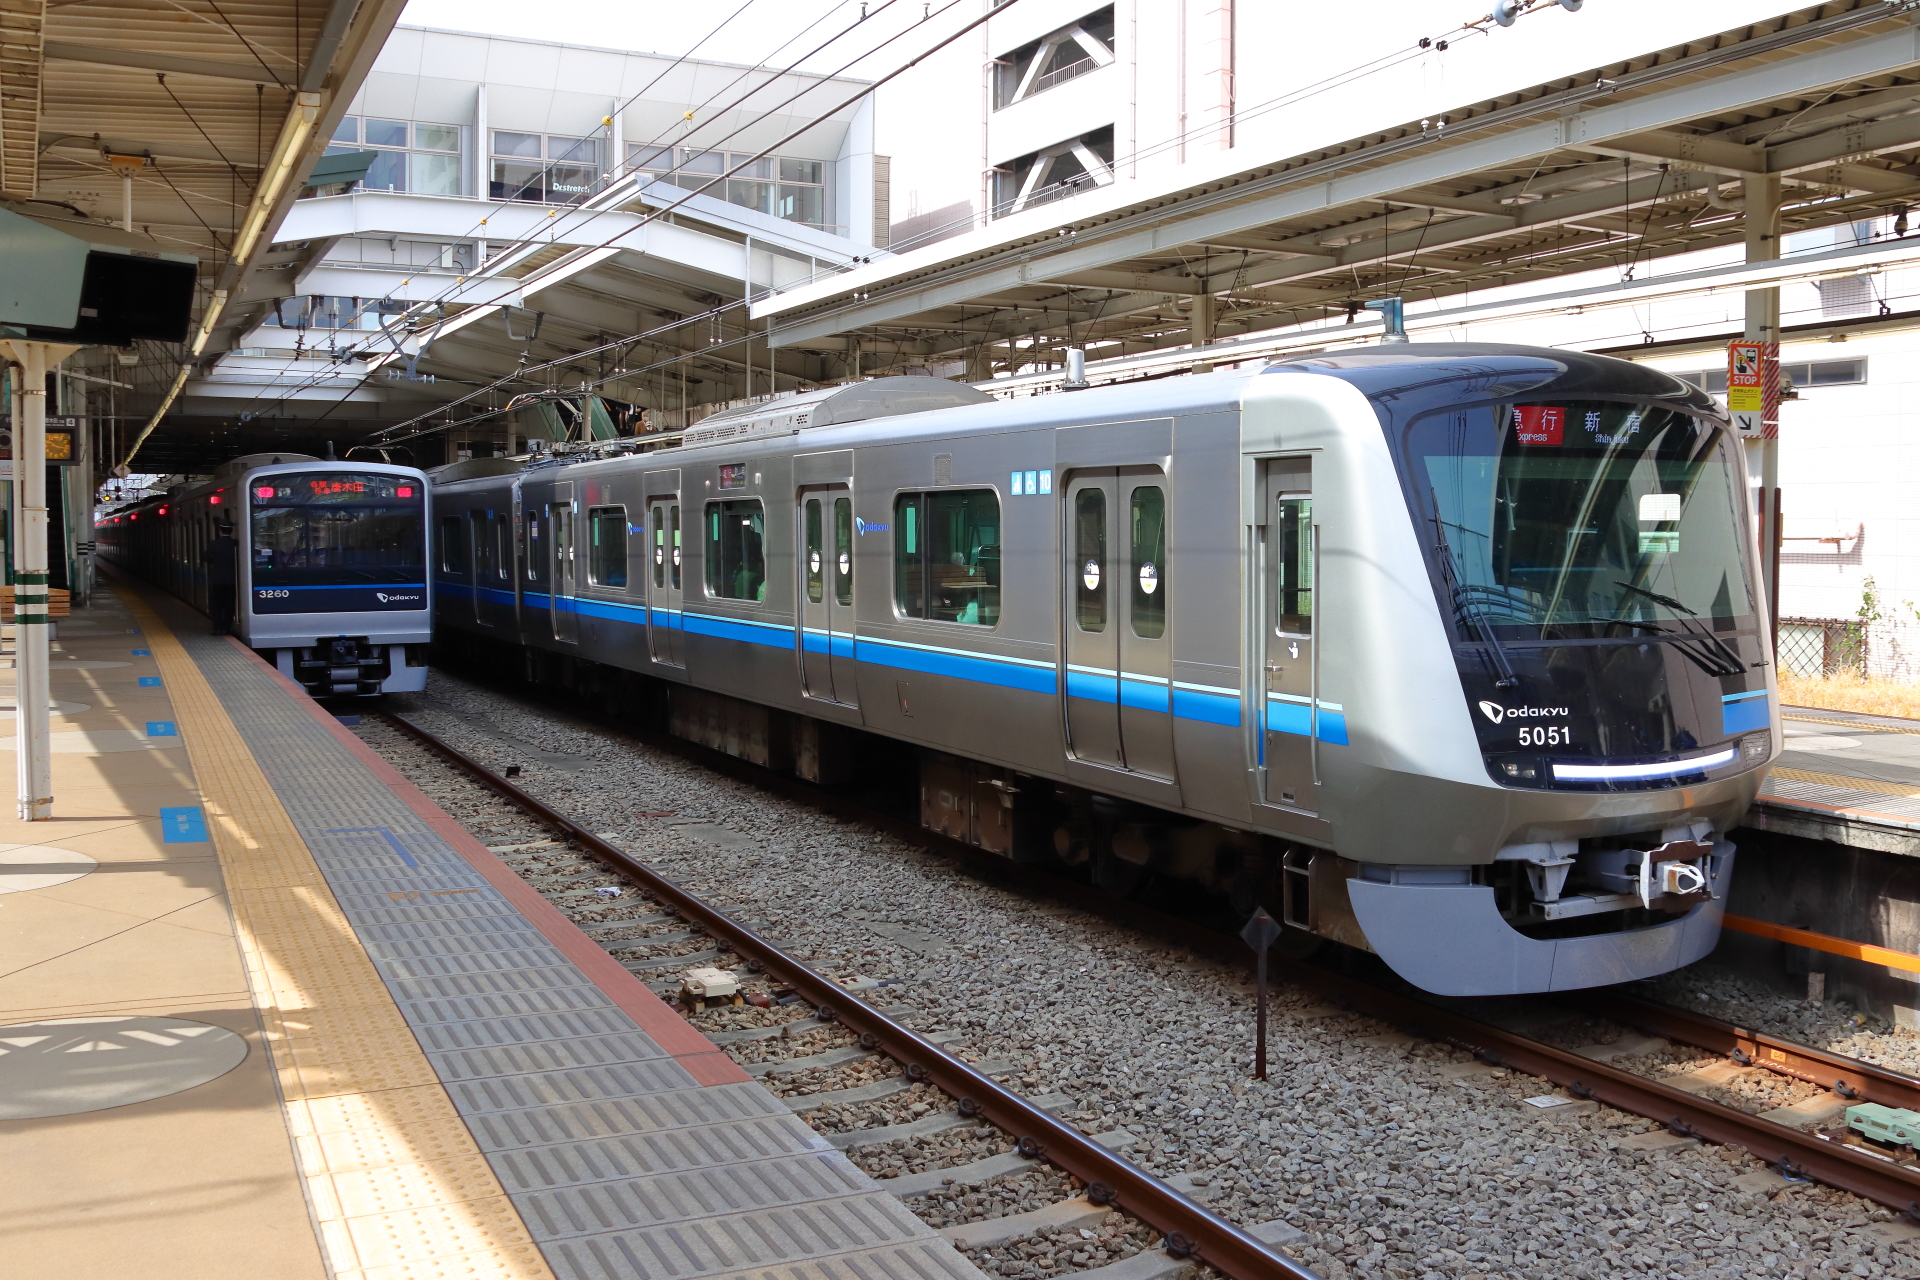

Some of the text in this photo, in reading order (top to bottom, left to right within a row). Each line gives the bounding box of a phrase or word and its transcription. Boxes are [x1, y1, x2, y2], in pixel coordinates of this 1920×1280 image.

[1733, 375, 1757, 385] STOP
[1585, 411, 1641, 433] 新宿
[1518, 433, 1548, 444] xpress
[1040, 474, 1051, 490] 10
[259, 589, 290, 598] 3260
[1506, 705, 1569, 718] odakyu
[1518, 726, 1570, 746] 5051
